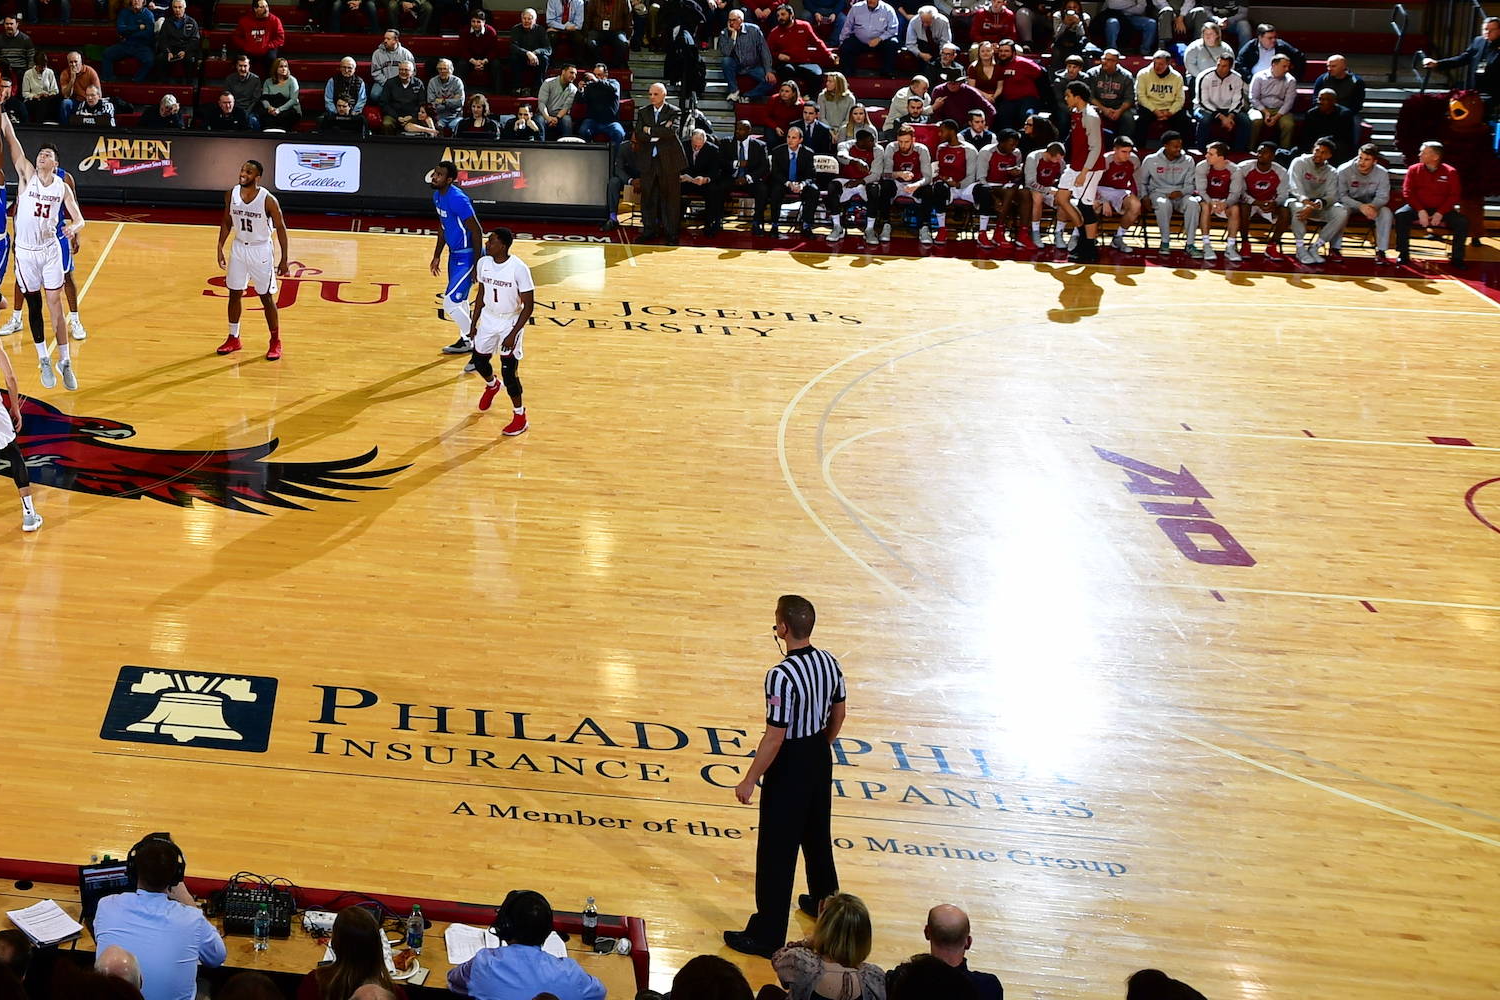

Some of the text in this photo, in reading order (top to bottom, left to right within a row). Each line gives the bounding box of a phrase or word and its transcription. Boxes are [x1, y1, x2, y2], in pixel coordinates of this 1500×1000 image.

[1150, 84, 1173, 93] ARMY
[78, 135, 173, 172] ARMEN
[288, 171, 346, 188] Cadillac
[34, 202, 51, 219] 33
[240, 218, 253, 233] 15
[493, 288, 498, 303] 1
[613, 300, 863, 325] JOSEPH'S
[1090, 444, 1258, 568] A10
[307, 731, 1096, 820] INSURANCE CPANIES
[450, 801, 477, 815] A
[488, 804, 632, 831] Member
[649, 816, 678, 834] of
[684, 819, 743, 840] the
[863, 836, 998, 863] Marine
[1008, 849, 1129, 877] Group
